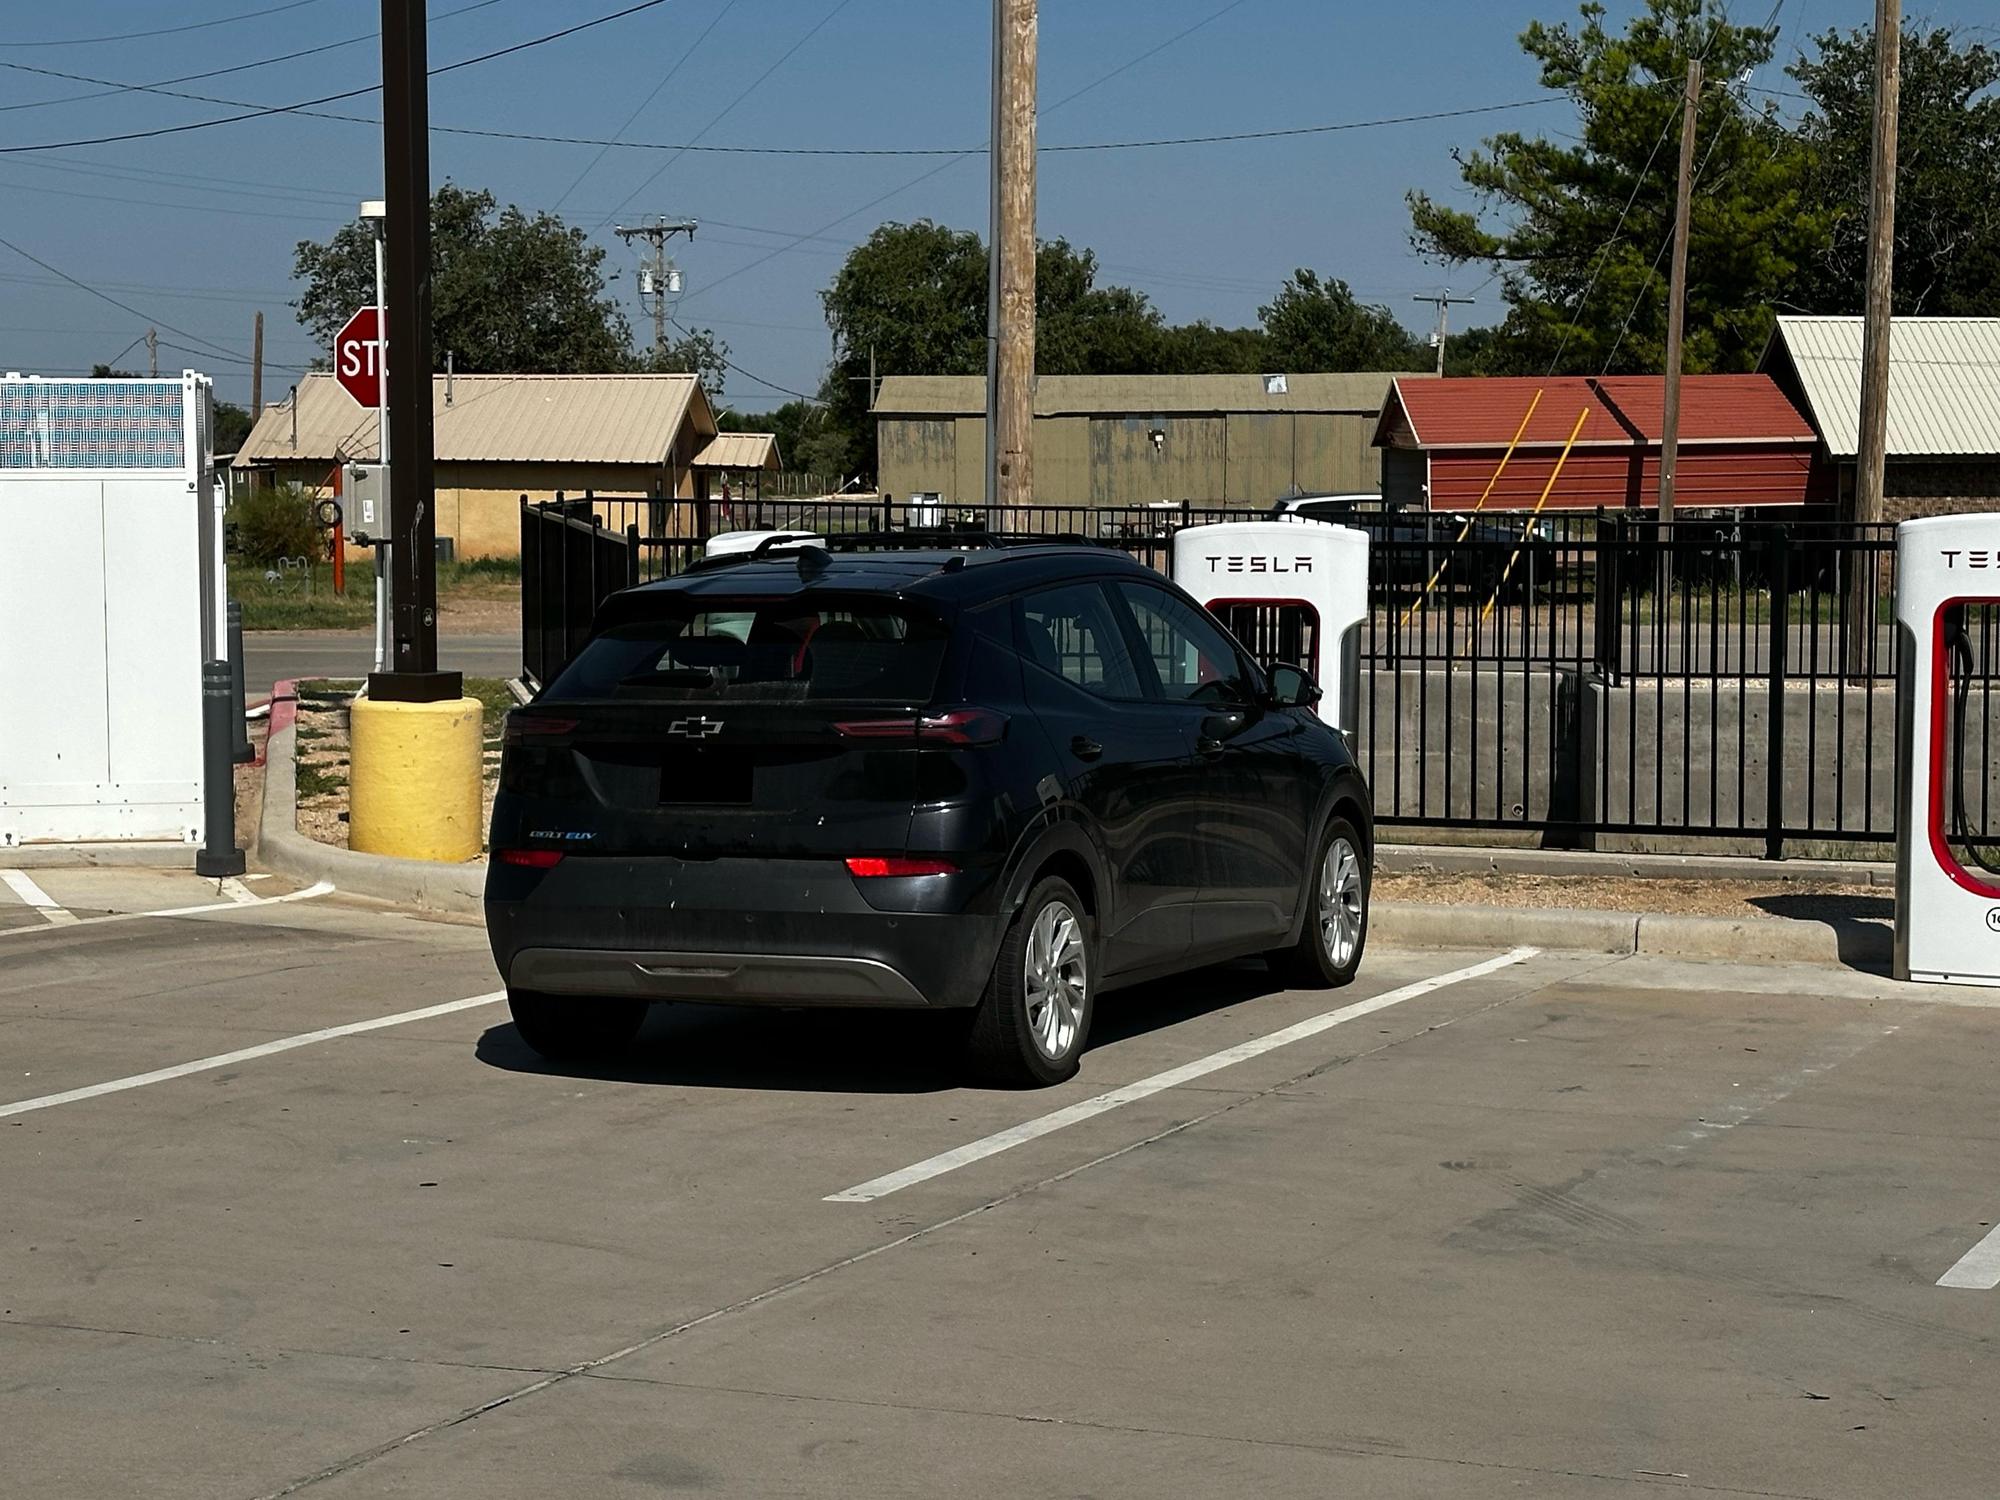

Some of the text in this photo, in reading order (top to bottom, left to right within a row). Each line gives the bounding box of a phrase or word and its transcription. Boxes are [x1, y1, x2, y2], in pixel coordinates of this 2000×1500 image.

[342, 340, 389, 377] ST
[1205, 556, 1312, 573] TESLA
[1940, 551, 2000, 569] TE
[565, 832, 597, 840] EUV
